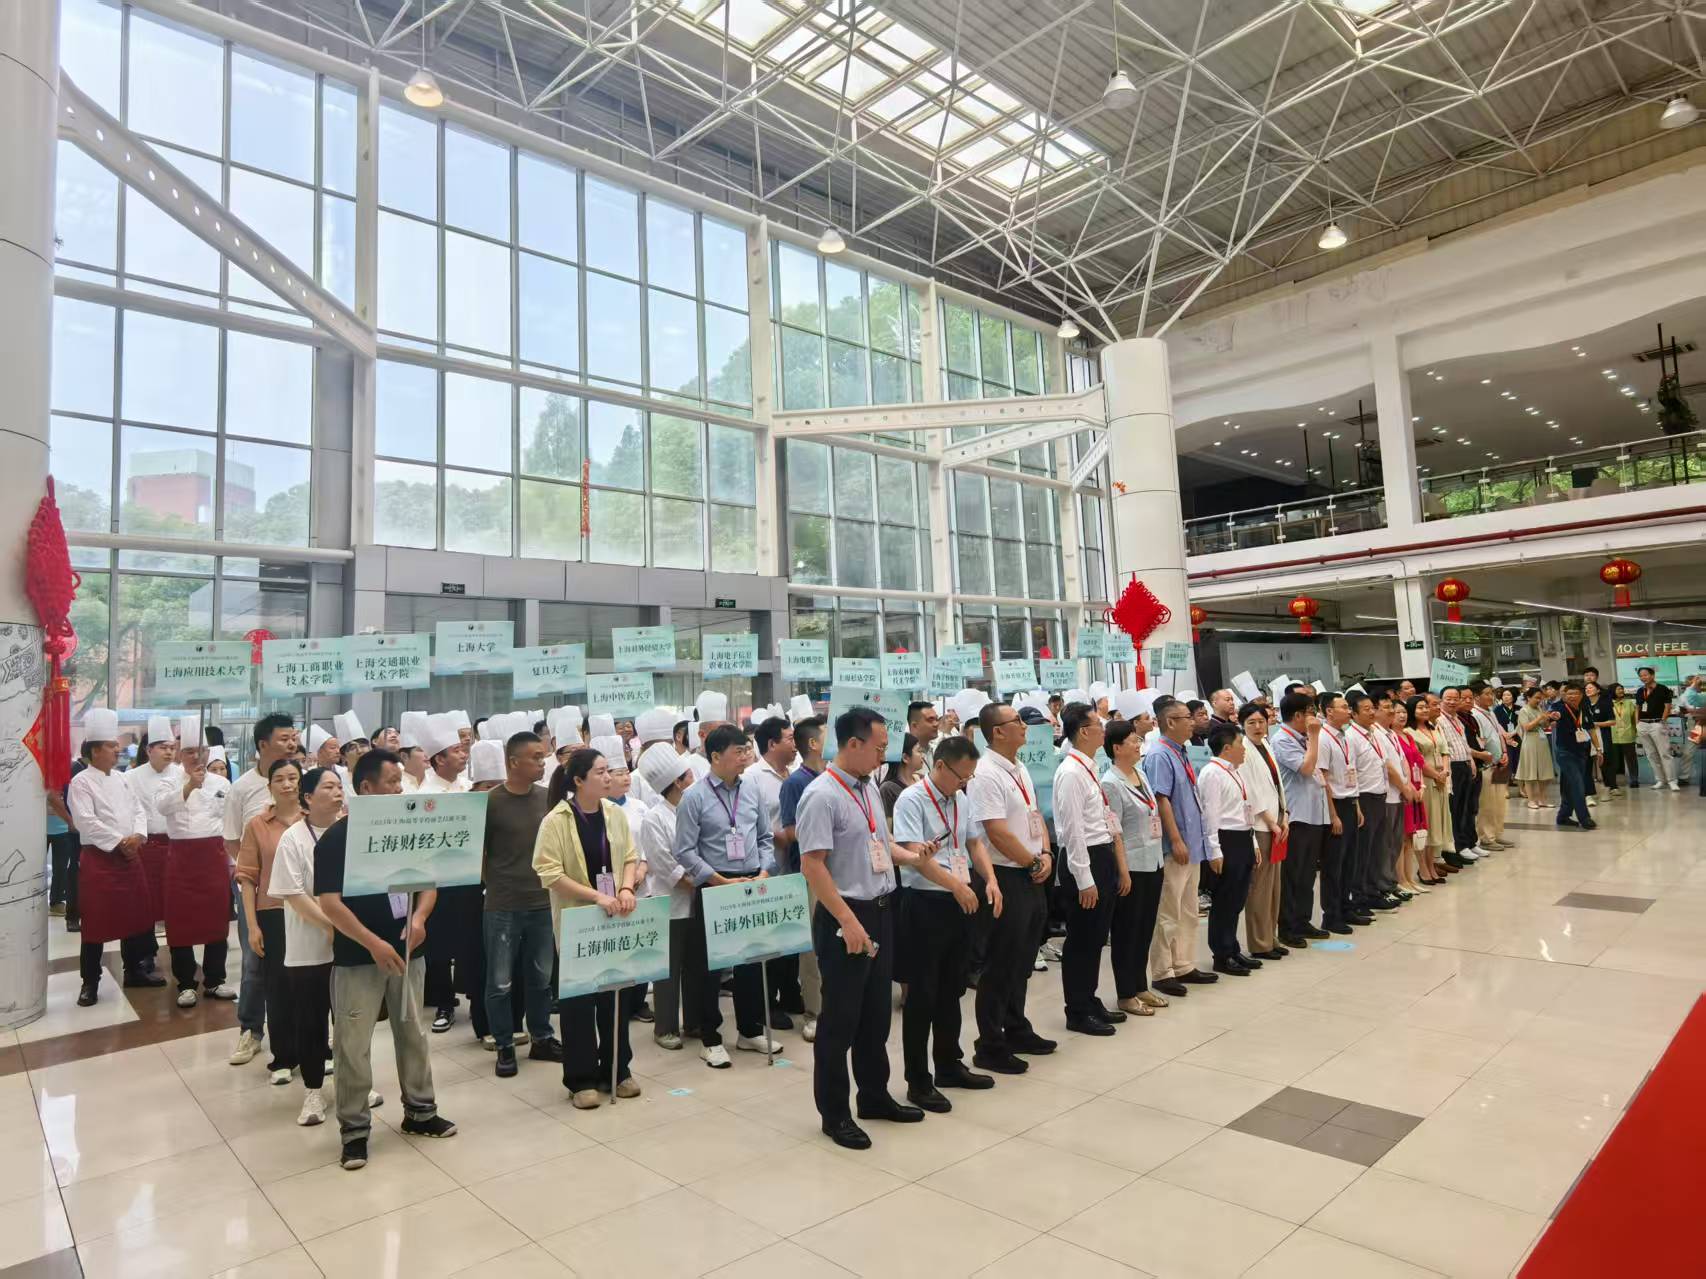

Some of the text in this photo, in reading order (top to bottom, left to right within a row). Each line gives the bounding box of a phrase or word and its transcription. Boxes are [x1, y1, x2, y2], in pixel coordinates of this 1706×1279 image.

[457, 642, 496, 653] 上海大学
[275, 660, 345, 674] 上海工商职业
[355, 656, 420, 669] 上海交通职业
[163, 665, 246, 678] 上海应用技术大学
[364, 668, 409, 681] 技术学院
[532, 664, 569, 676] 复旦大学
[286, 673, 333, 686] 技术学院
[593, 690, 650, 703] 上海中医药大学
[1017, 751, 1047, 763] 法大学
[367, 830, 470, 853] 上海财经大学
[712, 904, 805, 935] 上海外国语大学
[576, 930, 659, 958] 上海师范大学
